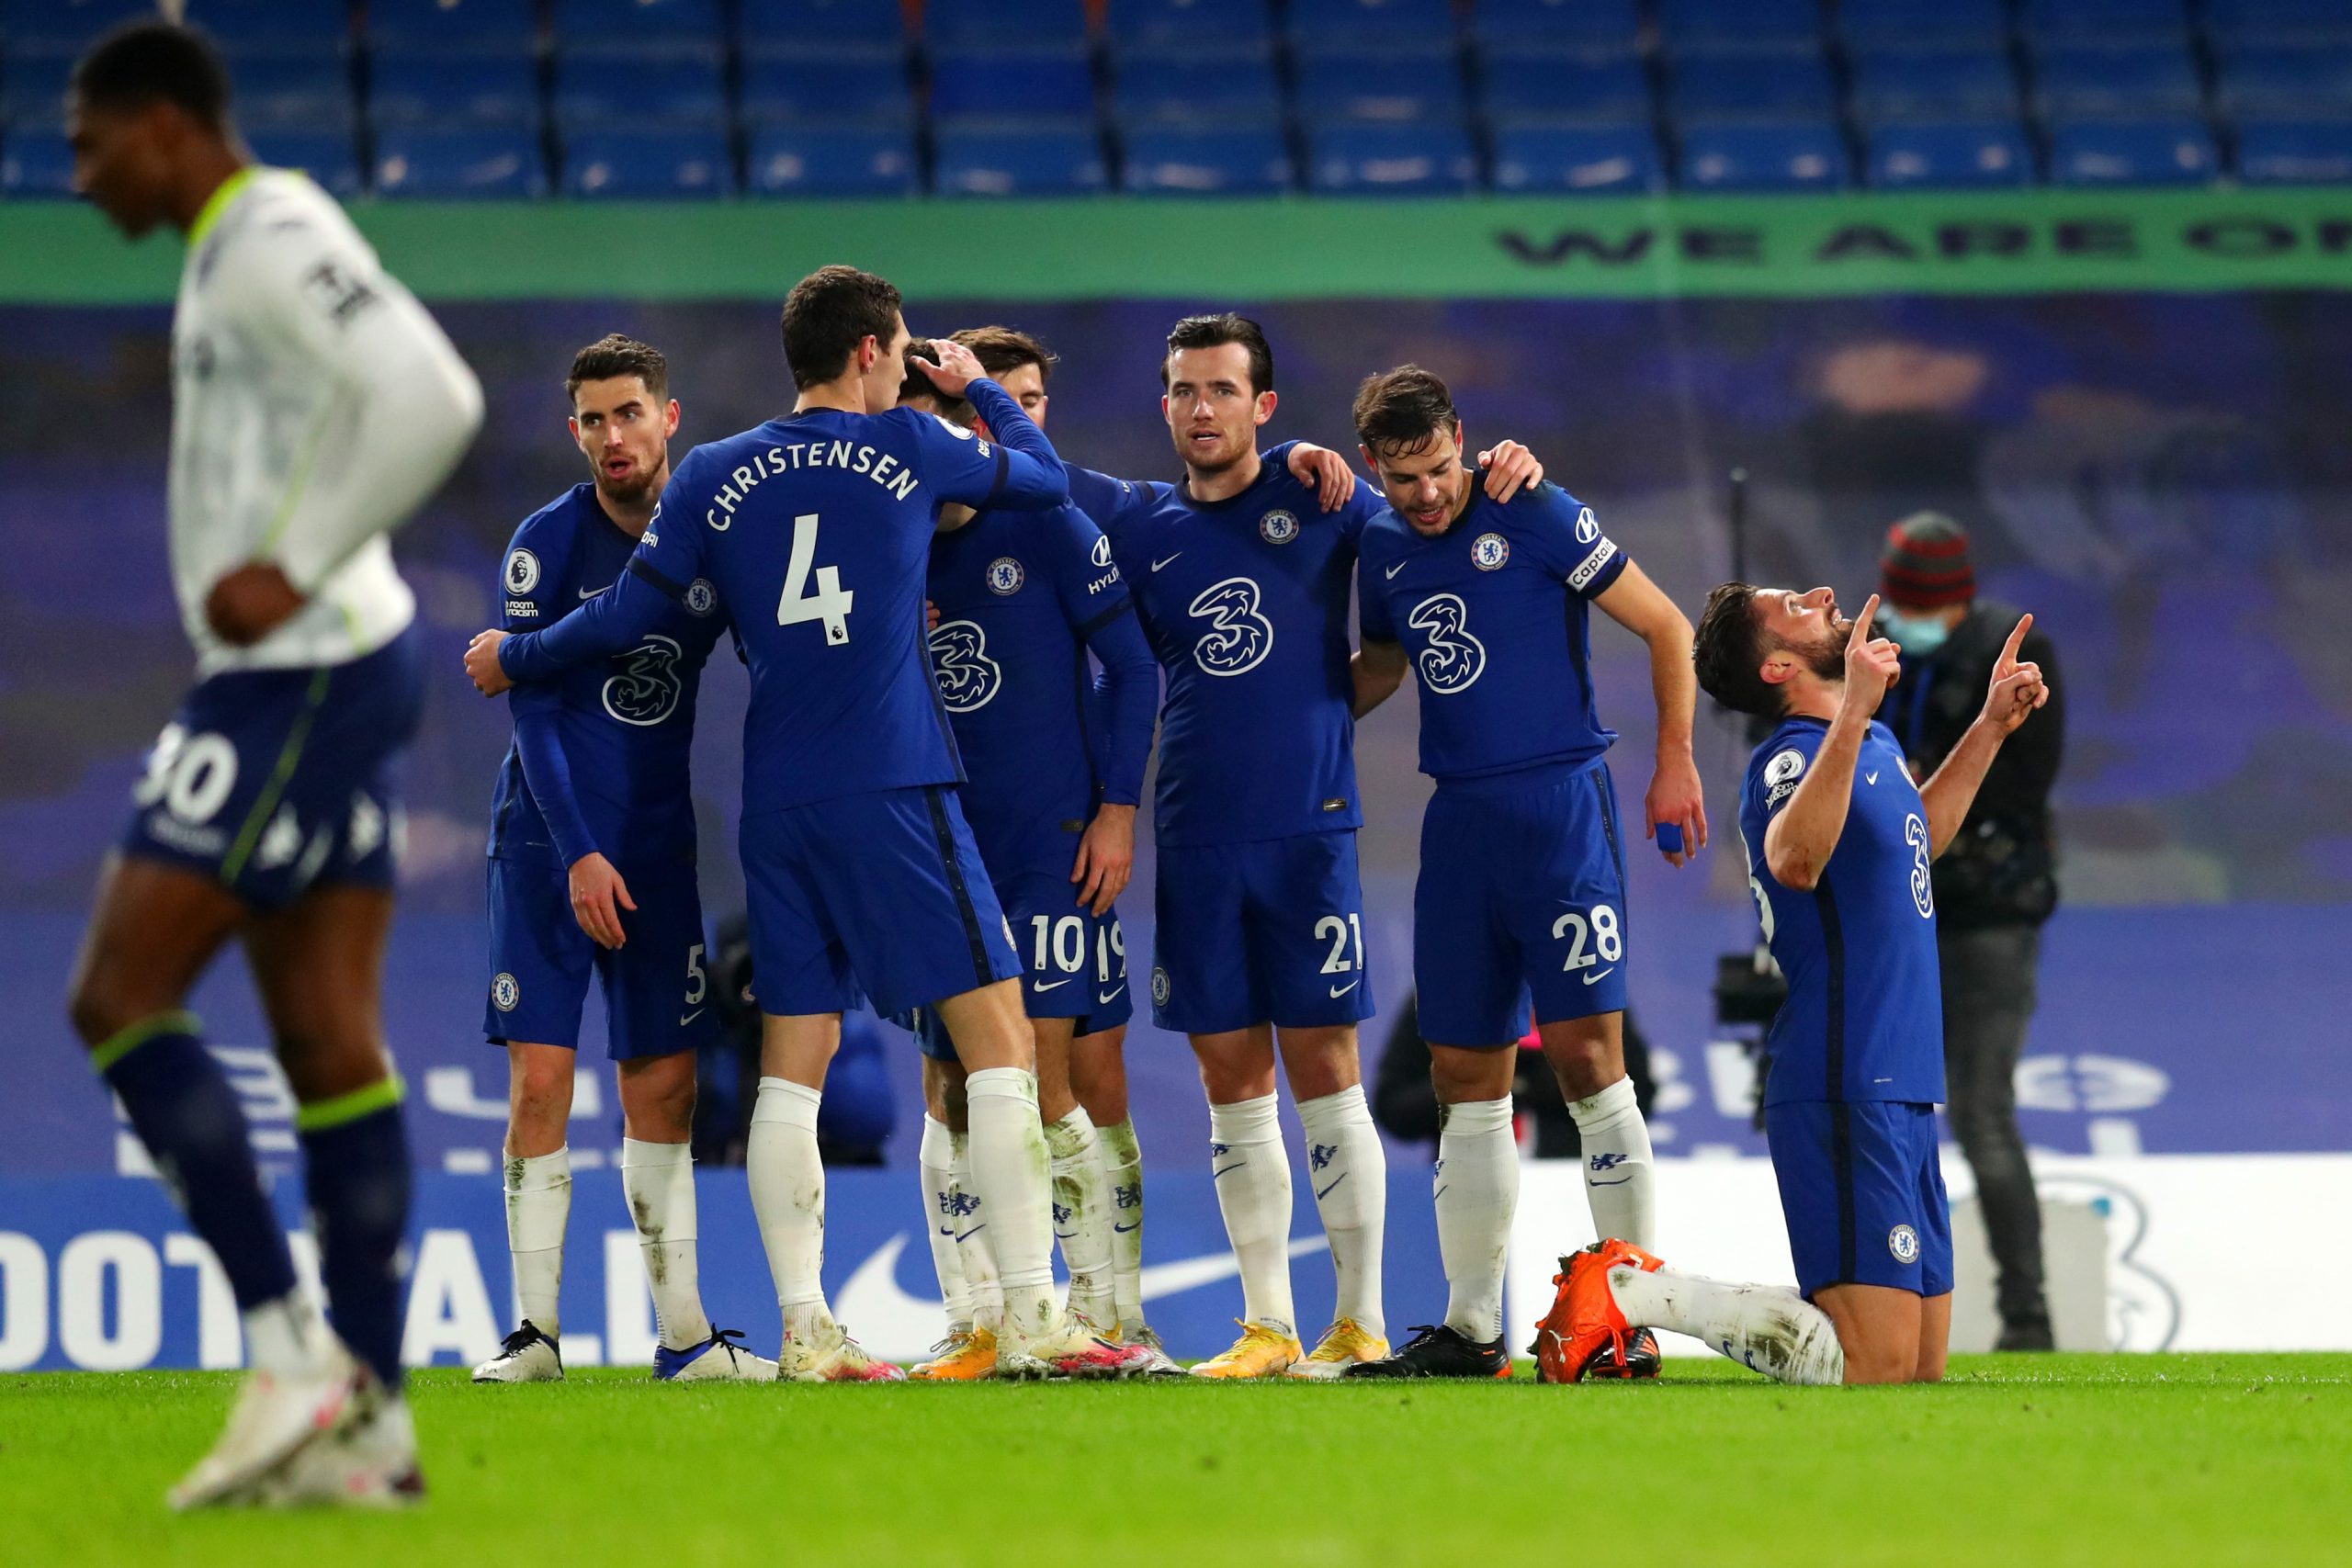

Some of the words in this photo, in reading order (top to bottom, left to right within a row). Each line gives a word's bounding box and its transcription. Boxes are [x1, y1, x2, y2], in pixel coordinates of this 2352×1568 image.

[1498, 224, 1767, 266] WE
[1815, 220, 2141, 264] ARE
[707, 440, 919, 532] CHRISTENSEN
[777, 513, 854, 646] 4
[1031, 915, 1084, 973] 10
[1315, 913, 1363, 974] 21
[1552, 905, 1622, 972] 28
[684, 943, 706, 1005] 5
